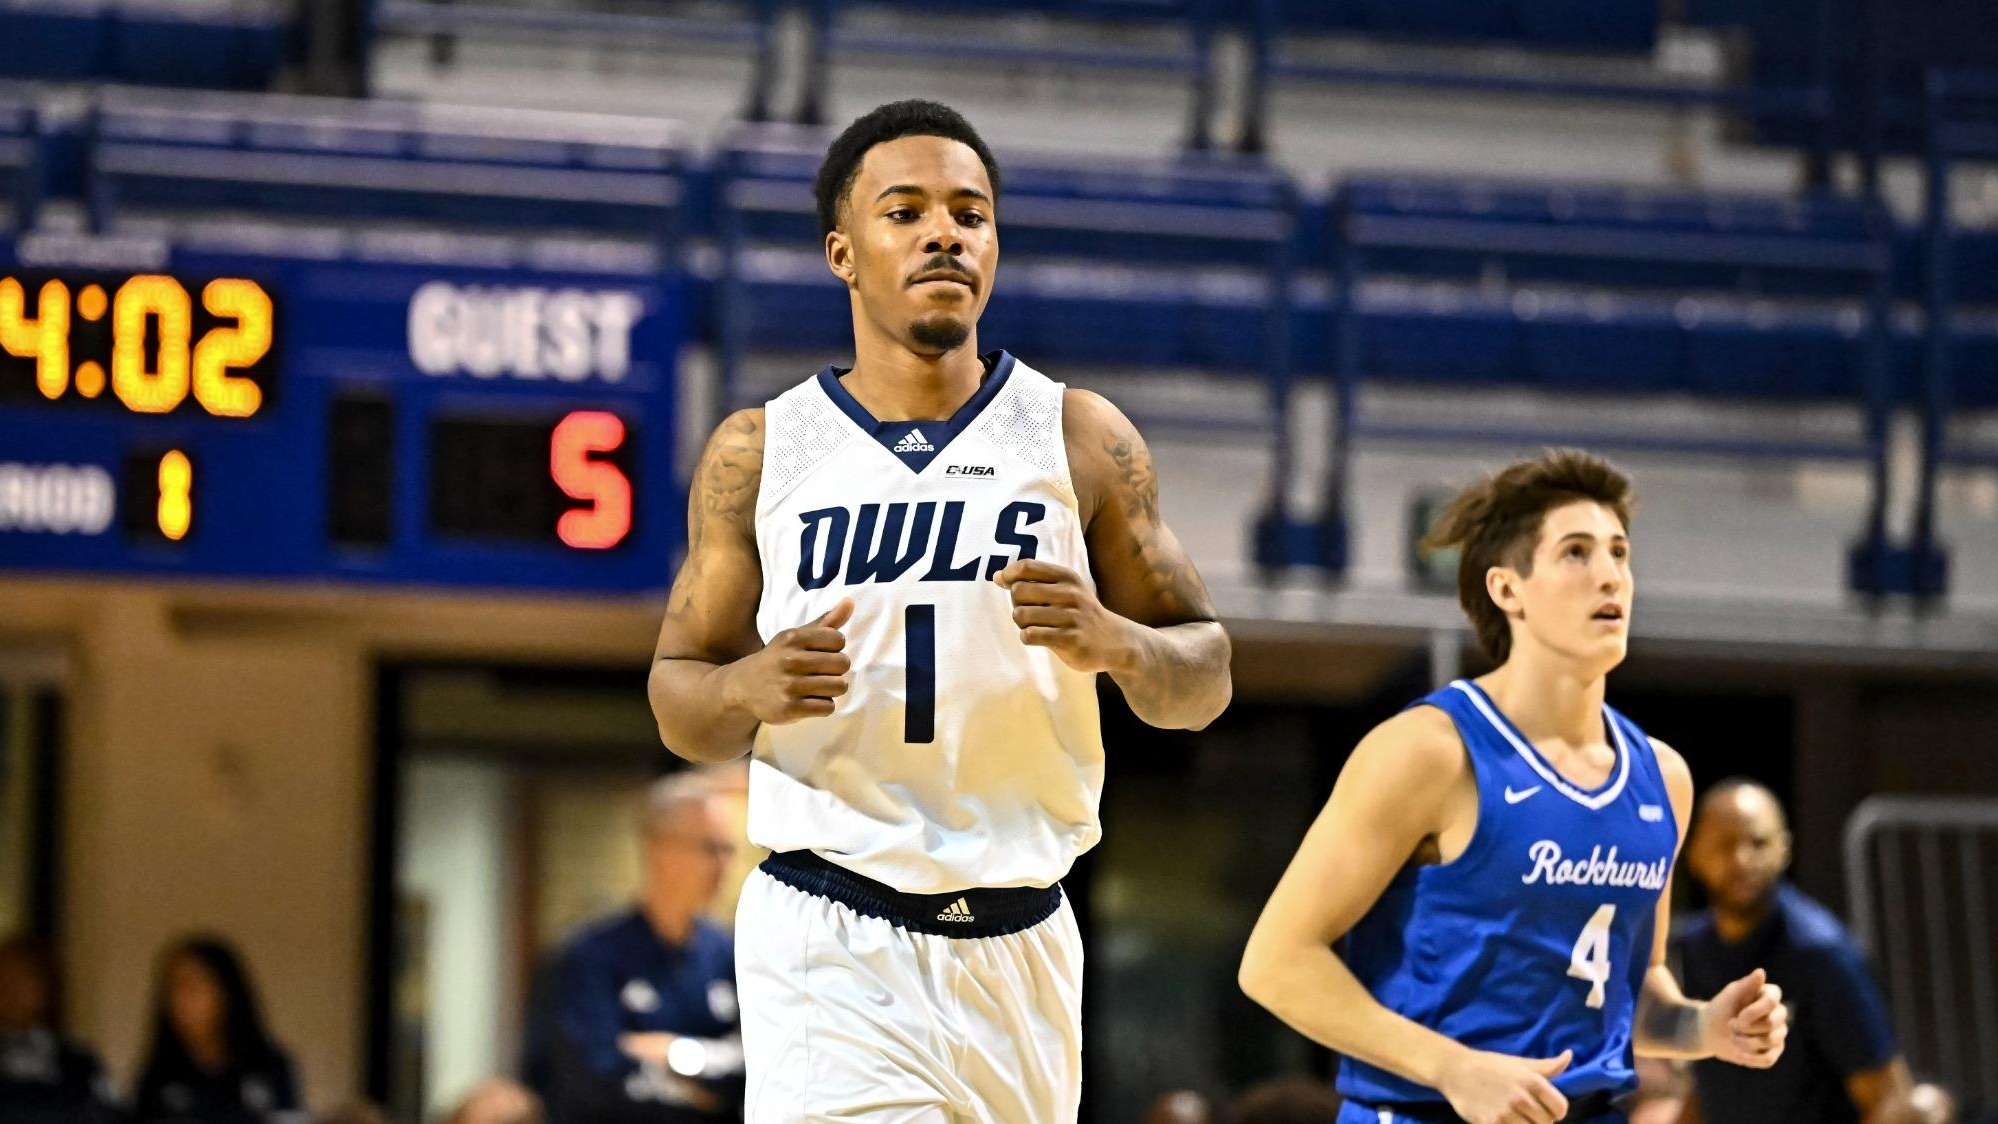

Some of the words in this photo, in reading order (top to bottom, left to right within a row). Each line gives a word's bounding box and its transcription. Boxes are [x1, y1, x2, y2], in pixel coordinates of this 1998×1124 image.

[0, 274, 273, 417] 4:02
[407, 281, 646, 382] GUEST
[157, 450, 192, 540] 1
[550, 411, 632, 548] 5
[893, 442, 935, 453] adidas
[797, 501, 1046, 592] OWLS
[904, 604, 935, 743] 1
[1522, 839, 1666, 890] Rockhurst
[936, 912, 975, 923] adidas
[1566, 904, 1617, 1009] 4
